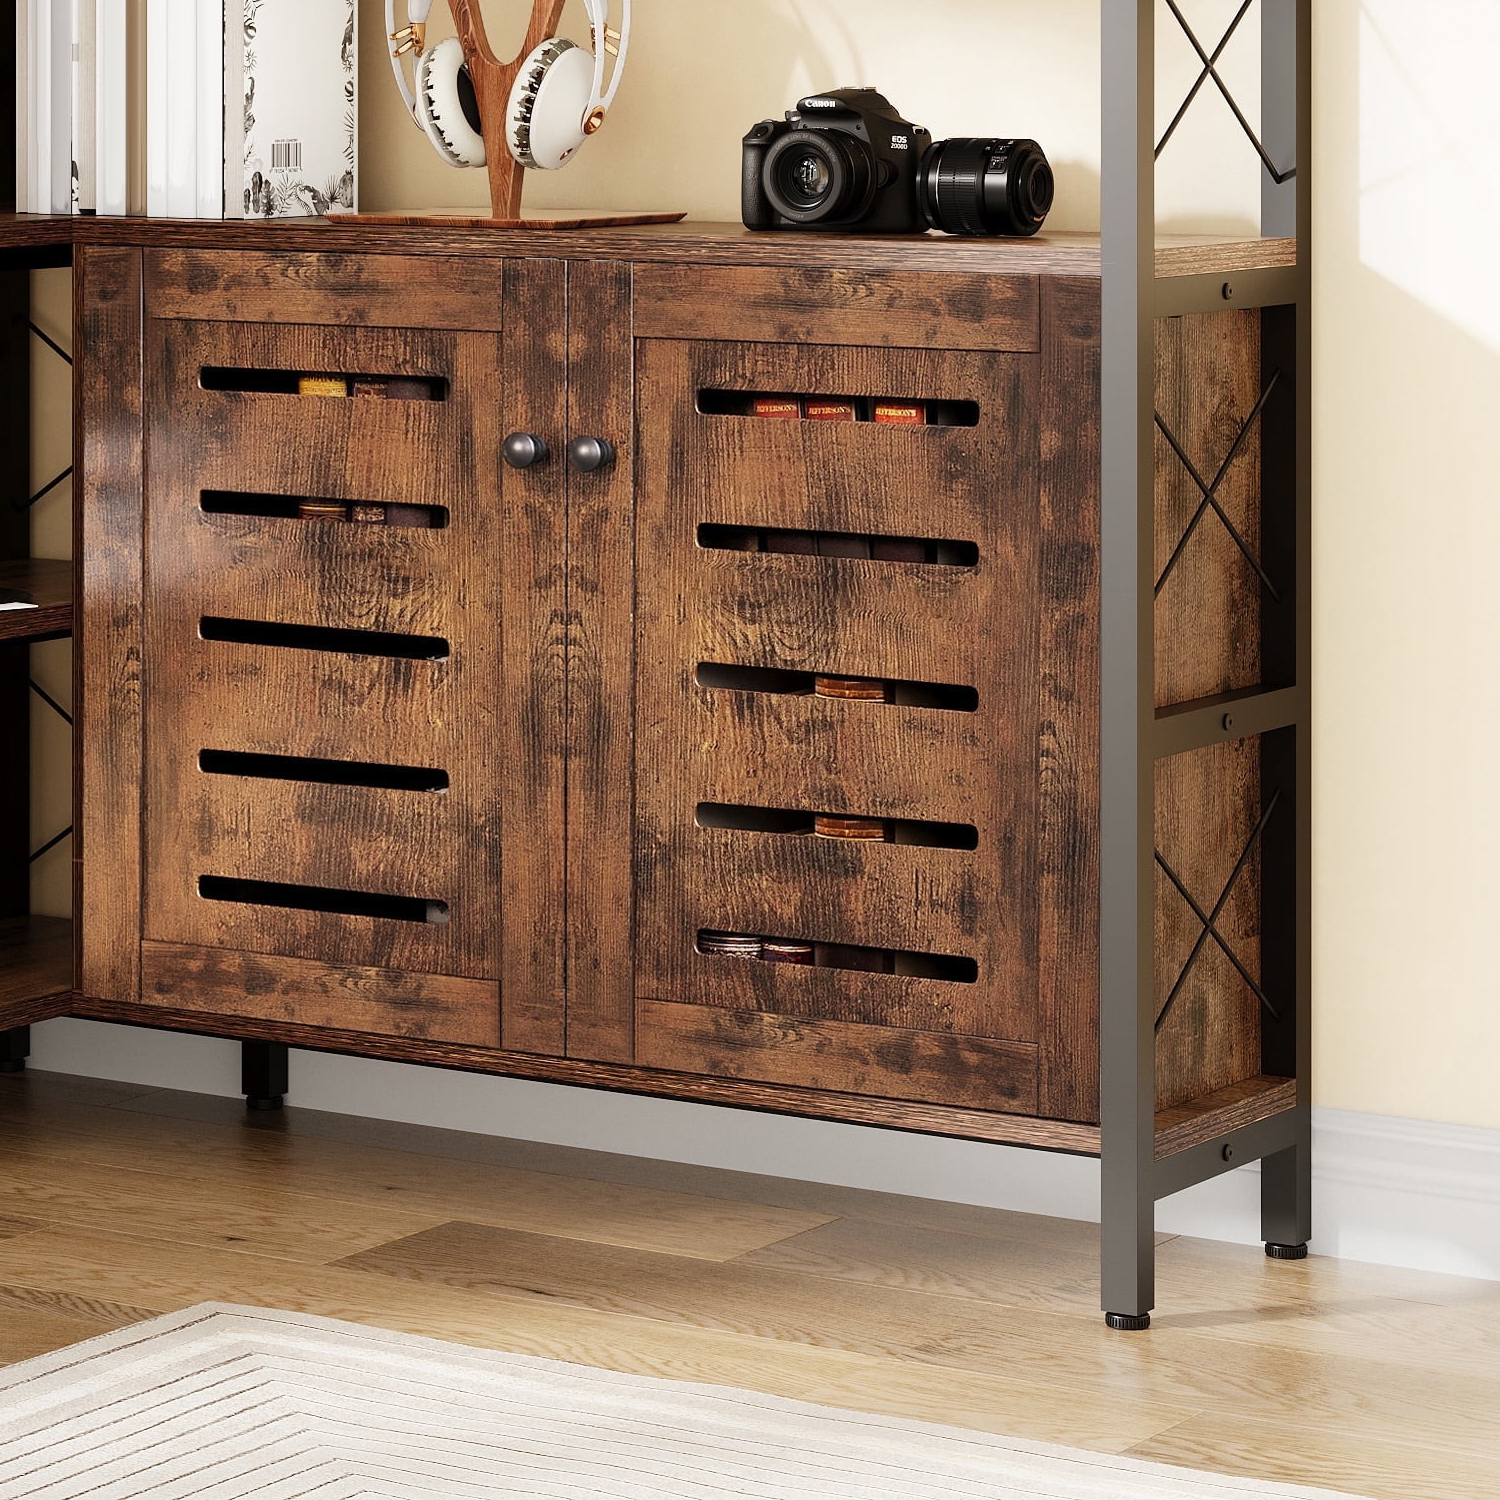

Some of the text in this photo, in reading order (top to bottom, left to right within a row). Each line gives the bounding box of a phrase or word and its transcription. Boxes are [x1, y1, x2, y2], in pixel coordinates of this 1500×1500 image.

[805, 100, 836, 108] Canon
[891, 135, 907, 144] EOS
[890, 142, 908, 150] 2000D
[756, 404, 797, 414] JEFFERSON'S
[808, 406, 851, 415] JEFFERSON'S
[875, 407, 917, 417] JEFFERSON'S
